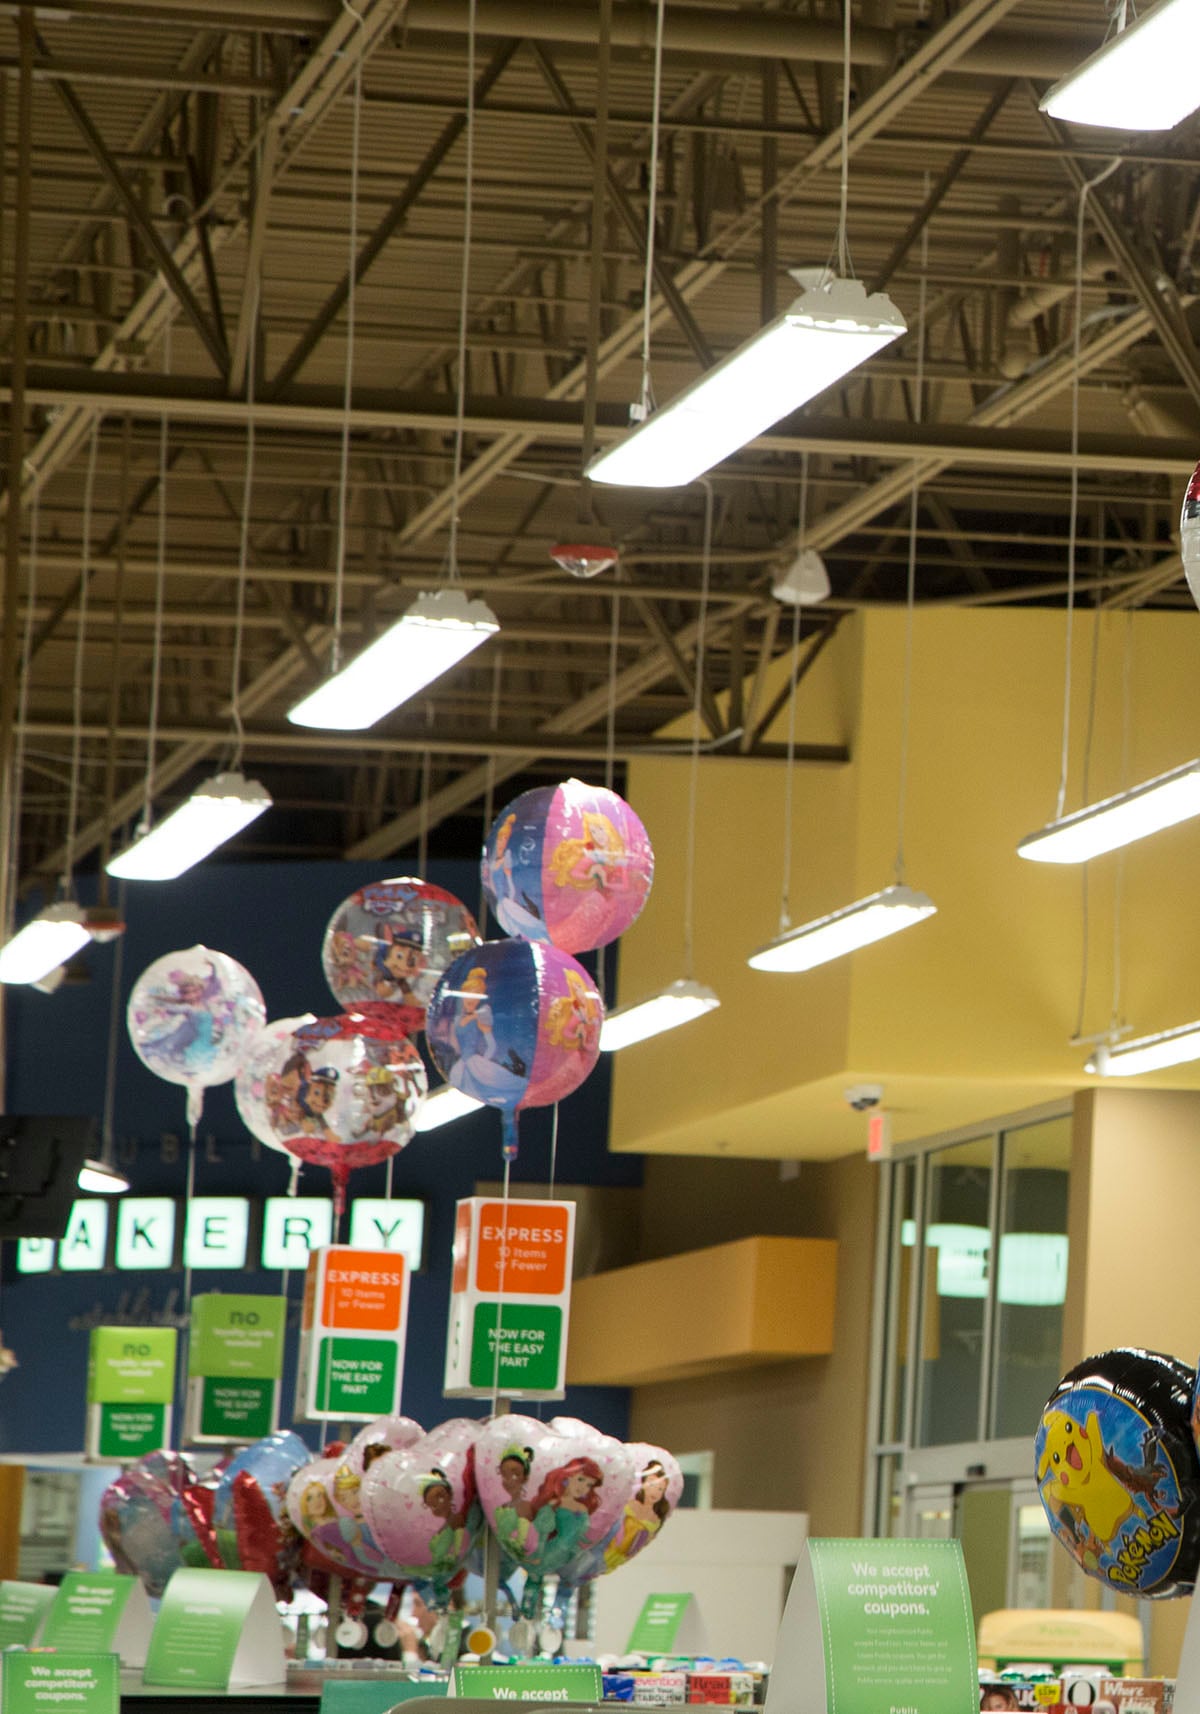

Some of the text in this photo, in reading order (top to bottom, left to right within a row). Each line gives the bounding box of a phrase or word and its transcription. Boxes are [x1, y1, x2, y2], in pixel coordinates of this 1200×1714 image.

[482, 1226, 564, 1243] EXPRESS
[512, 1246, 547, 1259] Items
[512, 1260, 547, 1272] Fewer
[328, 1270, 401, 1286] EXPRESS
[229, 1311, 260, 1325] no
[488, 1328, 546, 1342] NOW FOR
[123, 1343, 151, 1356] no
[488, 1342, 545, 1355] THE EASY
[332, 1359, 383, 1372] NOW FOR
[501, 1356, 530, 1368] PART
[332, 1371, 382, 1384] THE EASY
[852, 1562, 930, 1581] We accept
[847, 1581, 940, 1599] competitors'
[863, 1602, 930, 1619] coupons.
[31, 1666, 92, 1680] We accept
[492, 1687, 569, 1700] We accept
